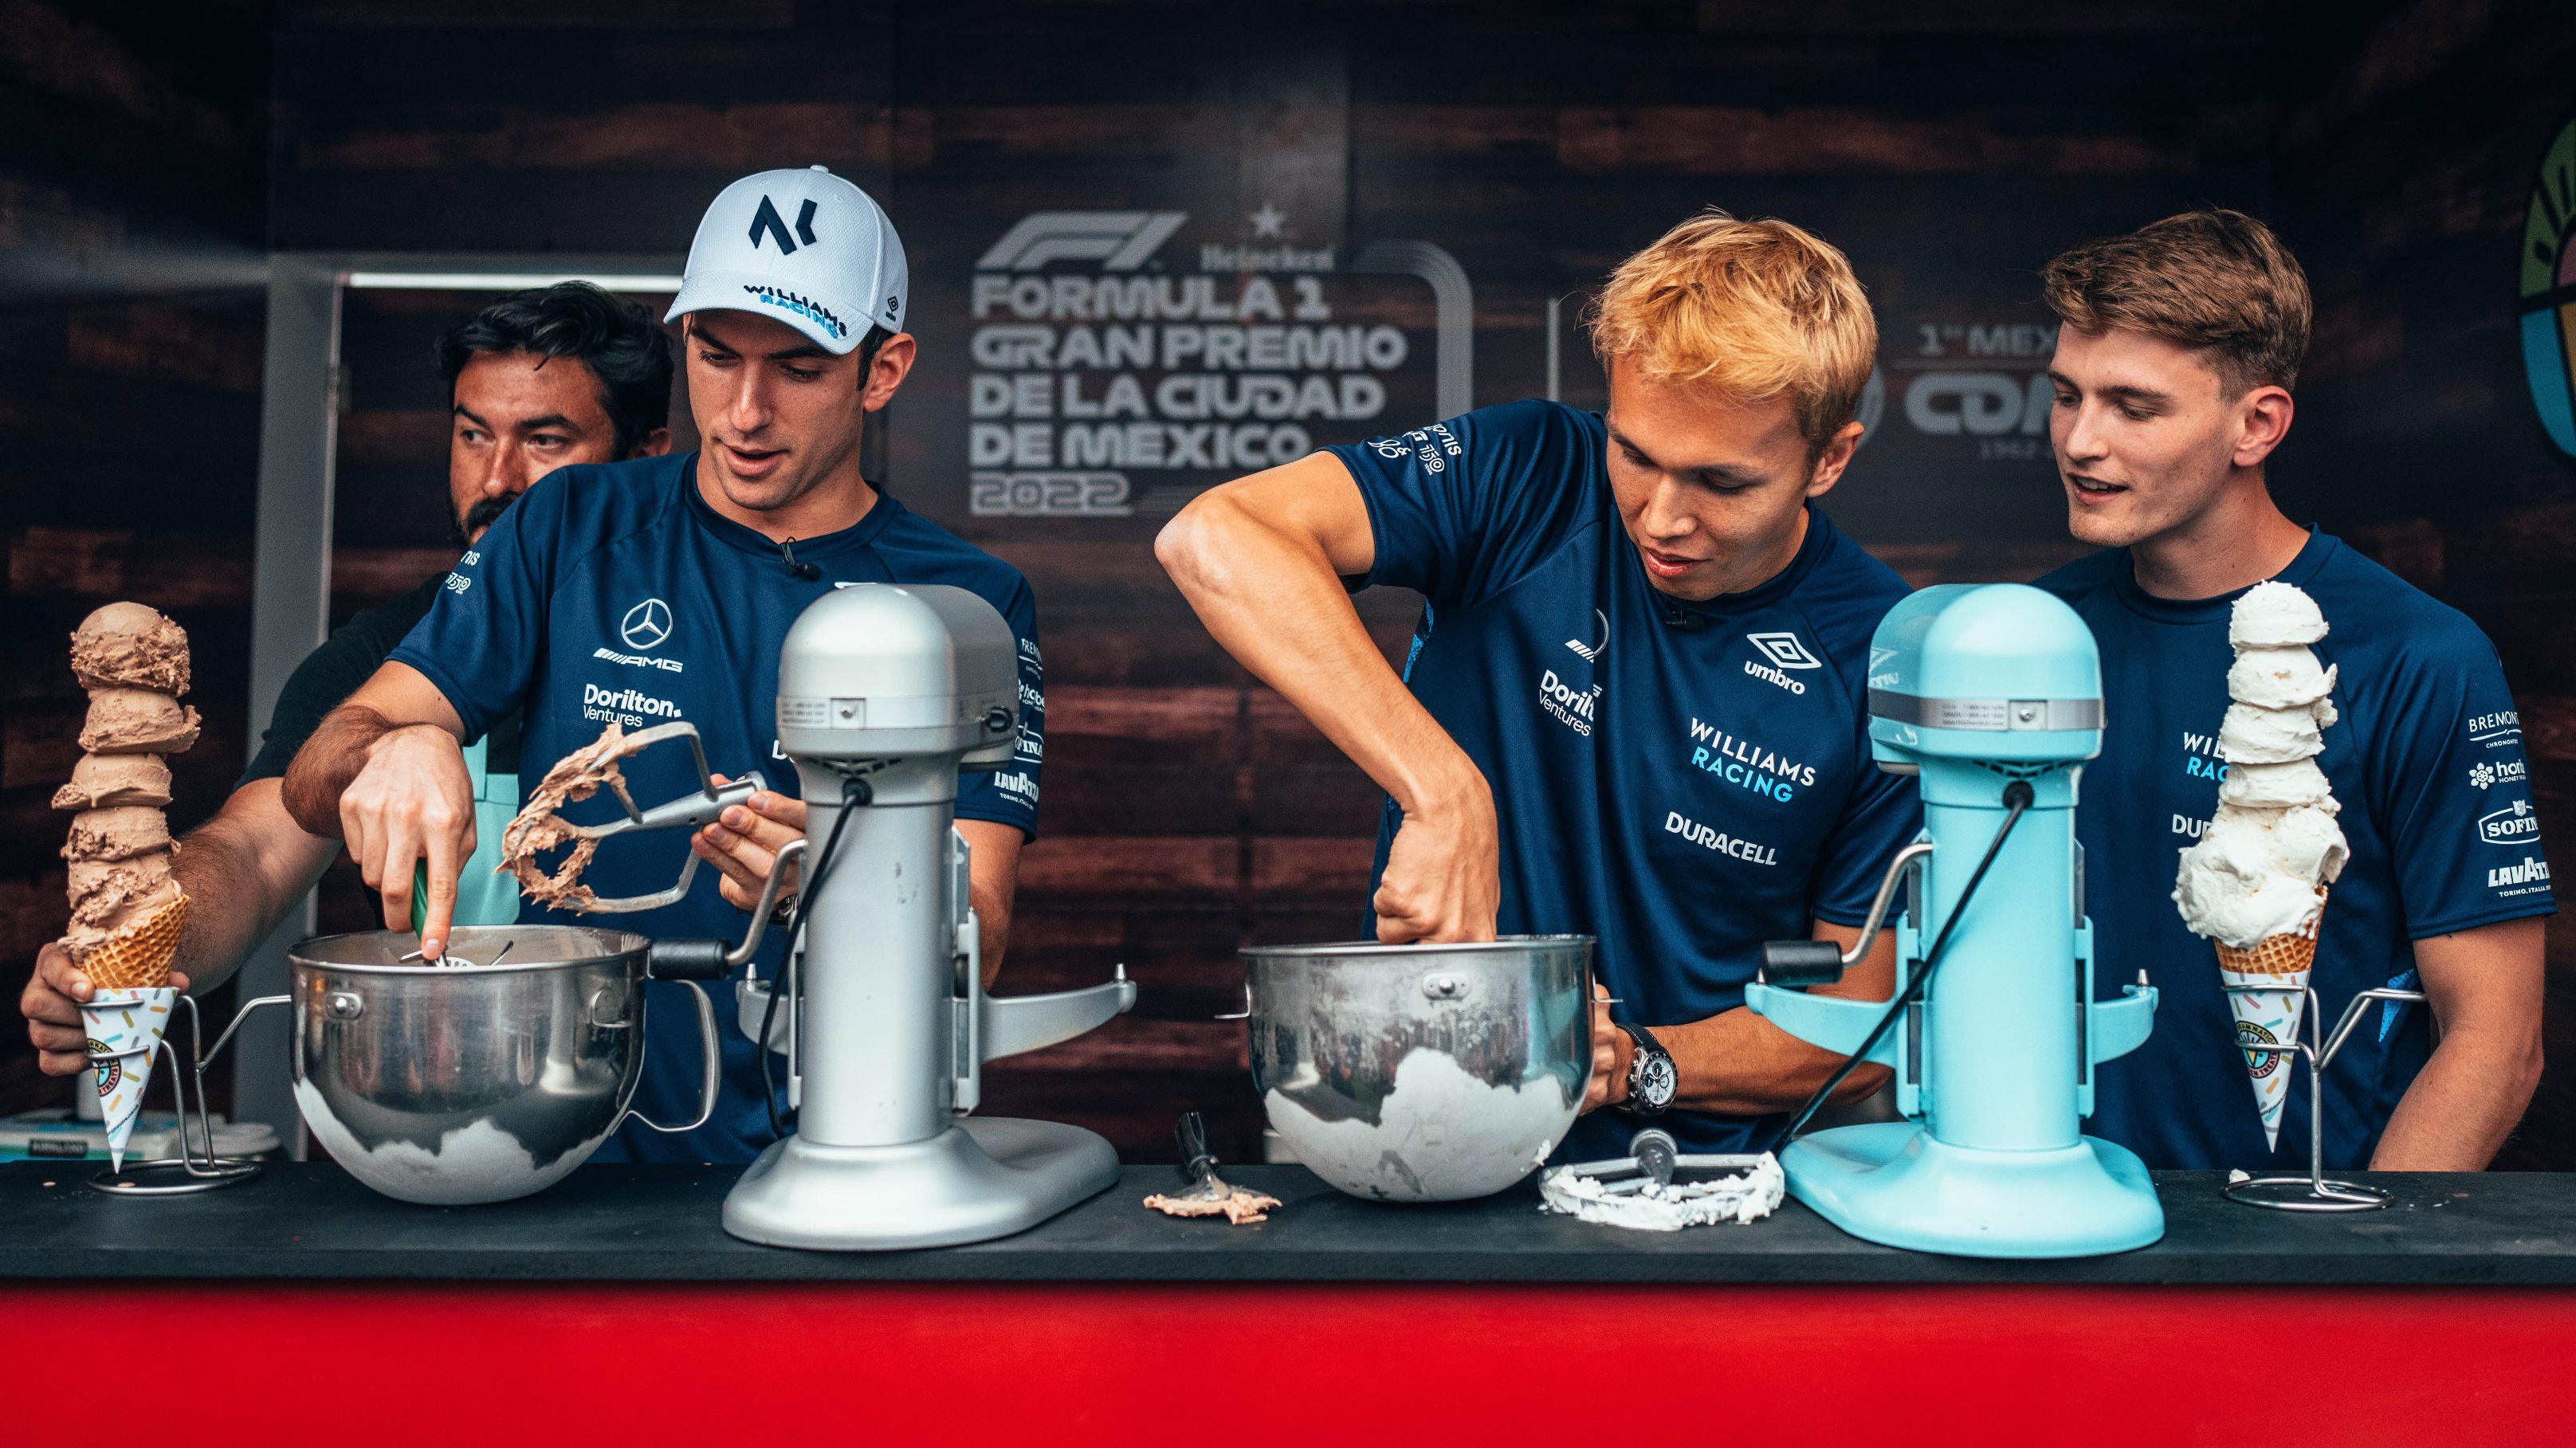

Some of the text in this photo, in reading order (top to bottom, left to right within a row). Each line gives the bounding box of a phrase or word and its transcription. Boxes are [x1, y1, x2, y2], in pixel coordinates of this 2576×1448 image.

[744, 284, 847, 337] WILLIAMS
[760, 294, 838, 339] RACING
[972, 276, 1330, 319] FORMULA 1
[971, 325, 1408, 370] GRAN PREMIO
[971, 376, 1386, 419] DE LA CIUDAD
[971, 423, 1312, 469] DE MEXICO
[970, 473, 1133, 516] 2022
[620, 654, 683, 673] AMG
[1744, 660, 1805, 695] umbro
[583, 704, 643, 728] Ventures
[1538, 689, 1591, 736] Ventures
[1690, 717, 1816, 787] WILLIAMS
[1691, 746, 1793, 802] RACING
[1664, 810, 1777, 865] DURACELL
[2487, 816, 2539, 838] SOFIN
